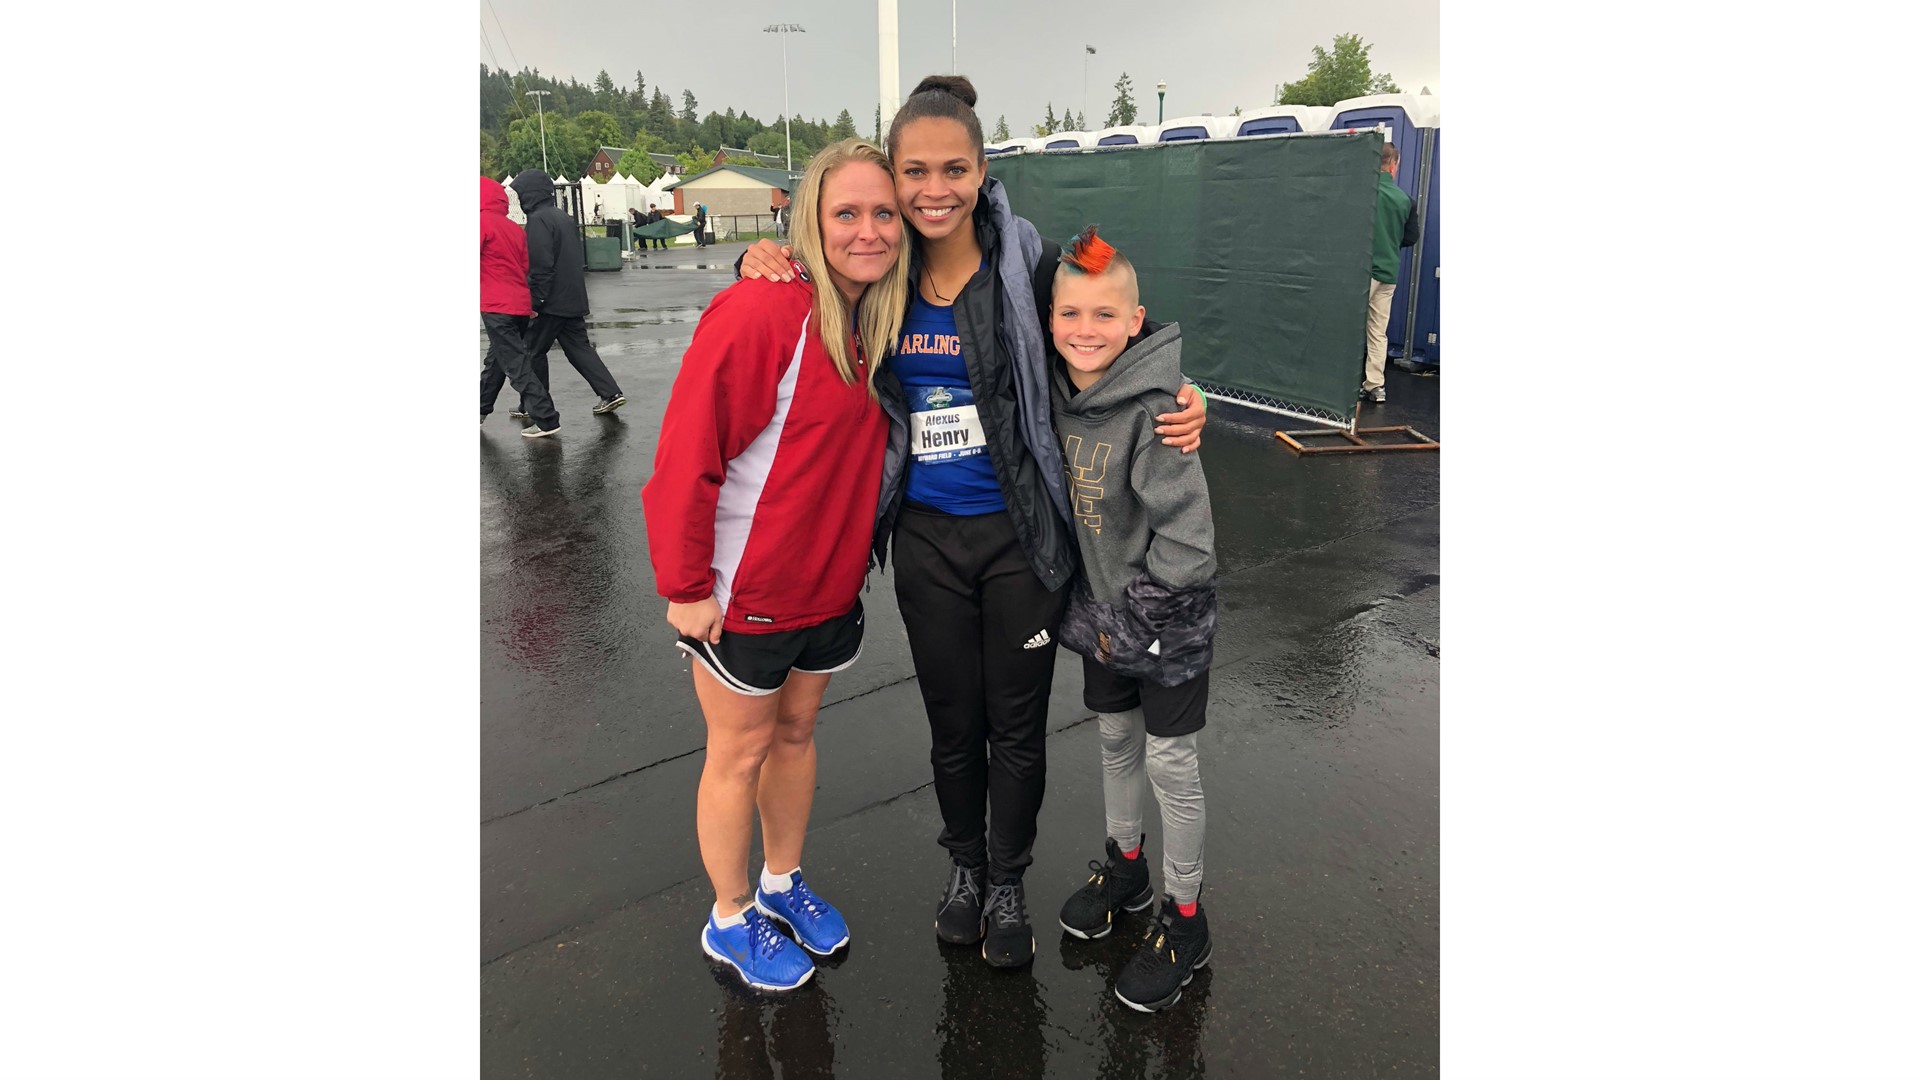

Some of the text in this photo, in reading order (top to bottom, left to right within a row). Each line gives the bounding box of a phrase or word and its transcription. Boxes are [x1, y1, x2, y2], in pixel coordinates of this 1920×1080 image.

[900, 333, 960, 356] ARLING
[925, 413, 960, 426] Alexus
[921, 428, 969, 448] Henry
